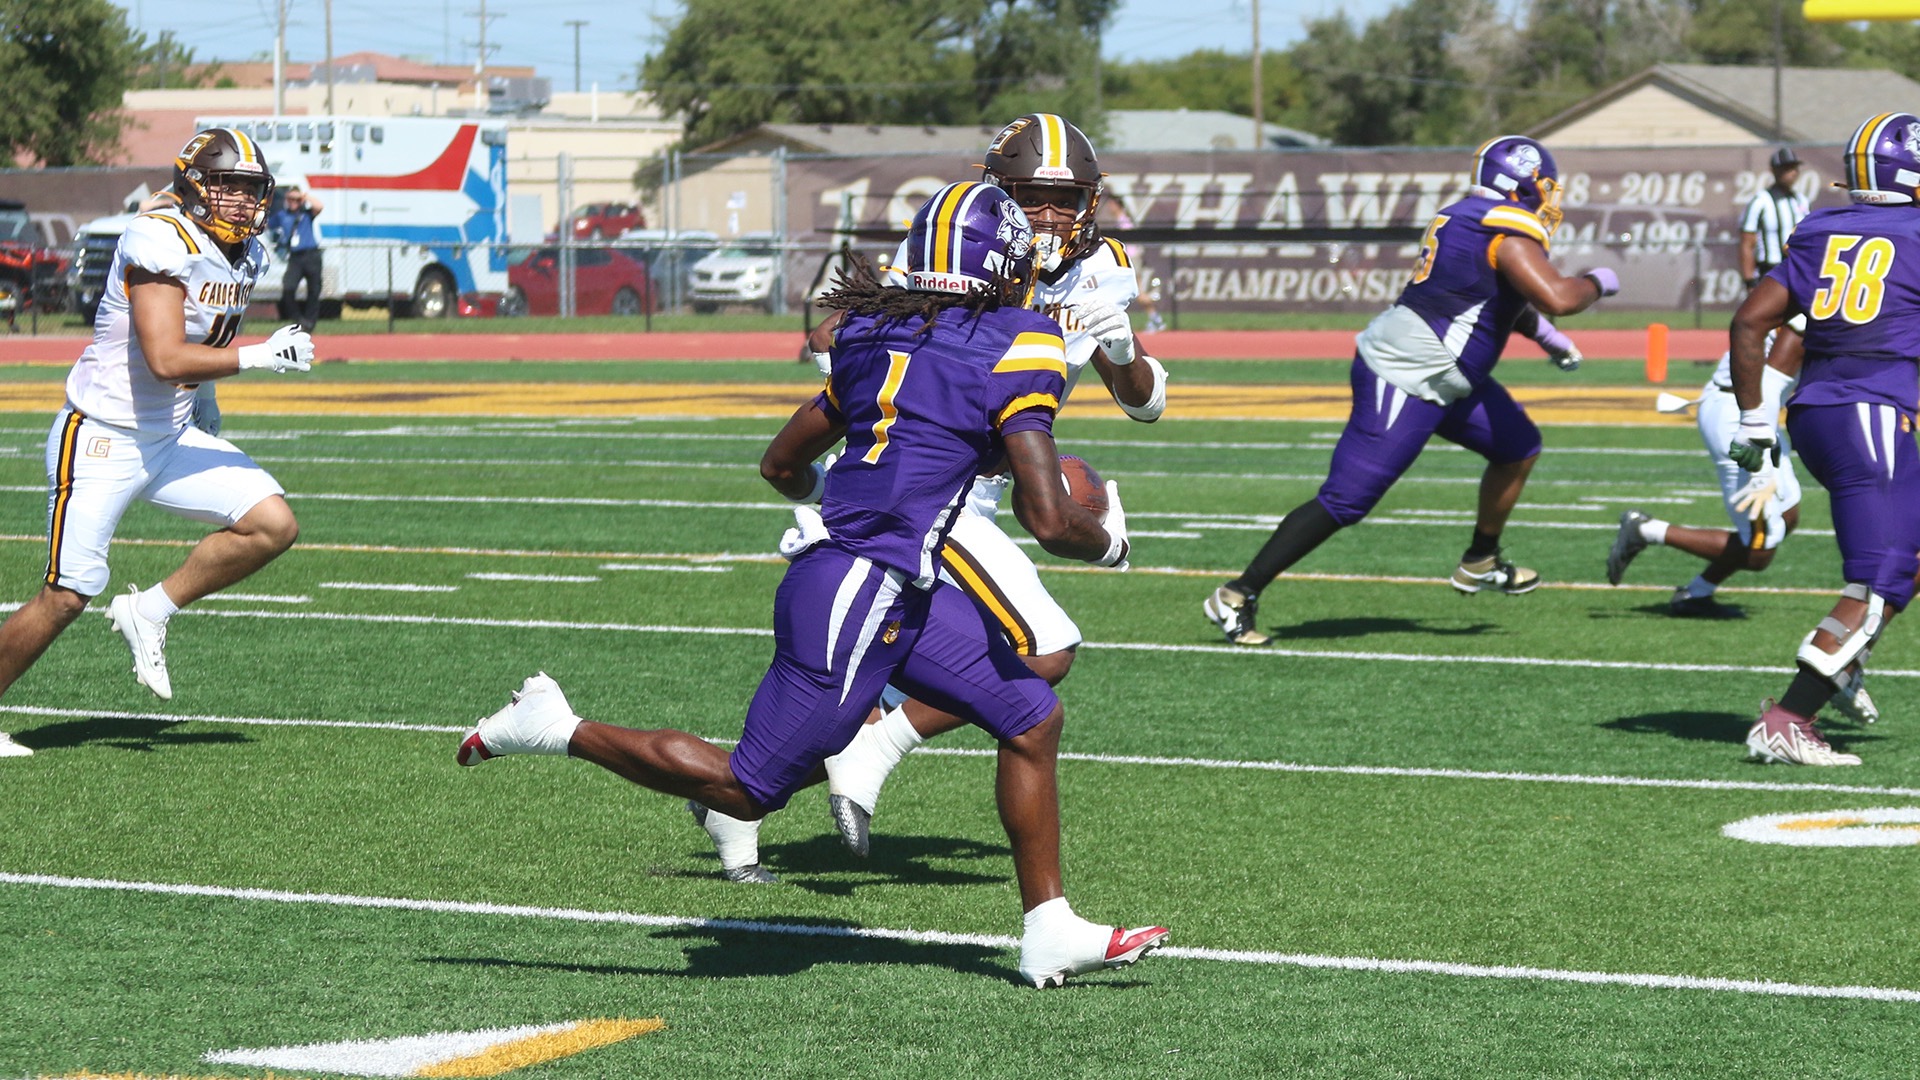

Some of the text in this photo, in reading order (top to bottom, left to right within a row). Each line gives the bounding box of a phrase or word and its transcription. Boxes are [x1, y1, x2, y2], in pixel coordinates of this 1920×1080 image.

[1040, 169, 1069, 177] Riddell
[1619, 170, 1707, 206] 2016
[1733, 170, 1820, 205] 200
[1624, 220, 1709, 256] 1991
[199, 281, 241, 306] GARDEN
[913, 275, 973, 291] Riddell
[1167, 266, 1412, 302] CHAMPIONSH
[1810, 235, 1895, 324] 58
[861, 350, 912, 465] 1
[86, 436, 111, 458] G
